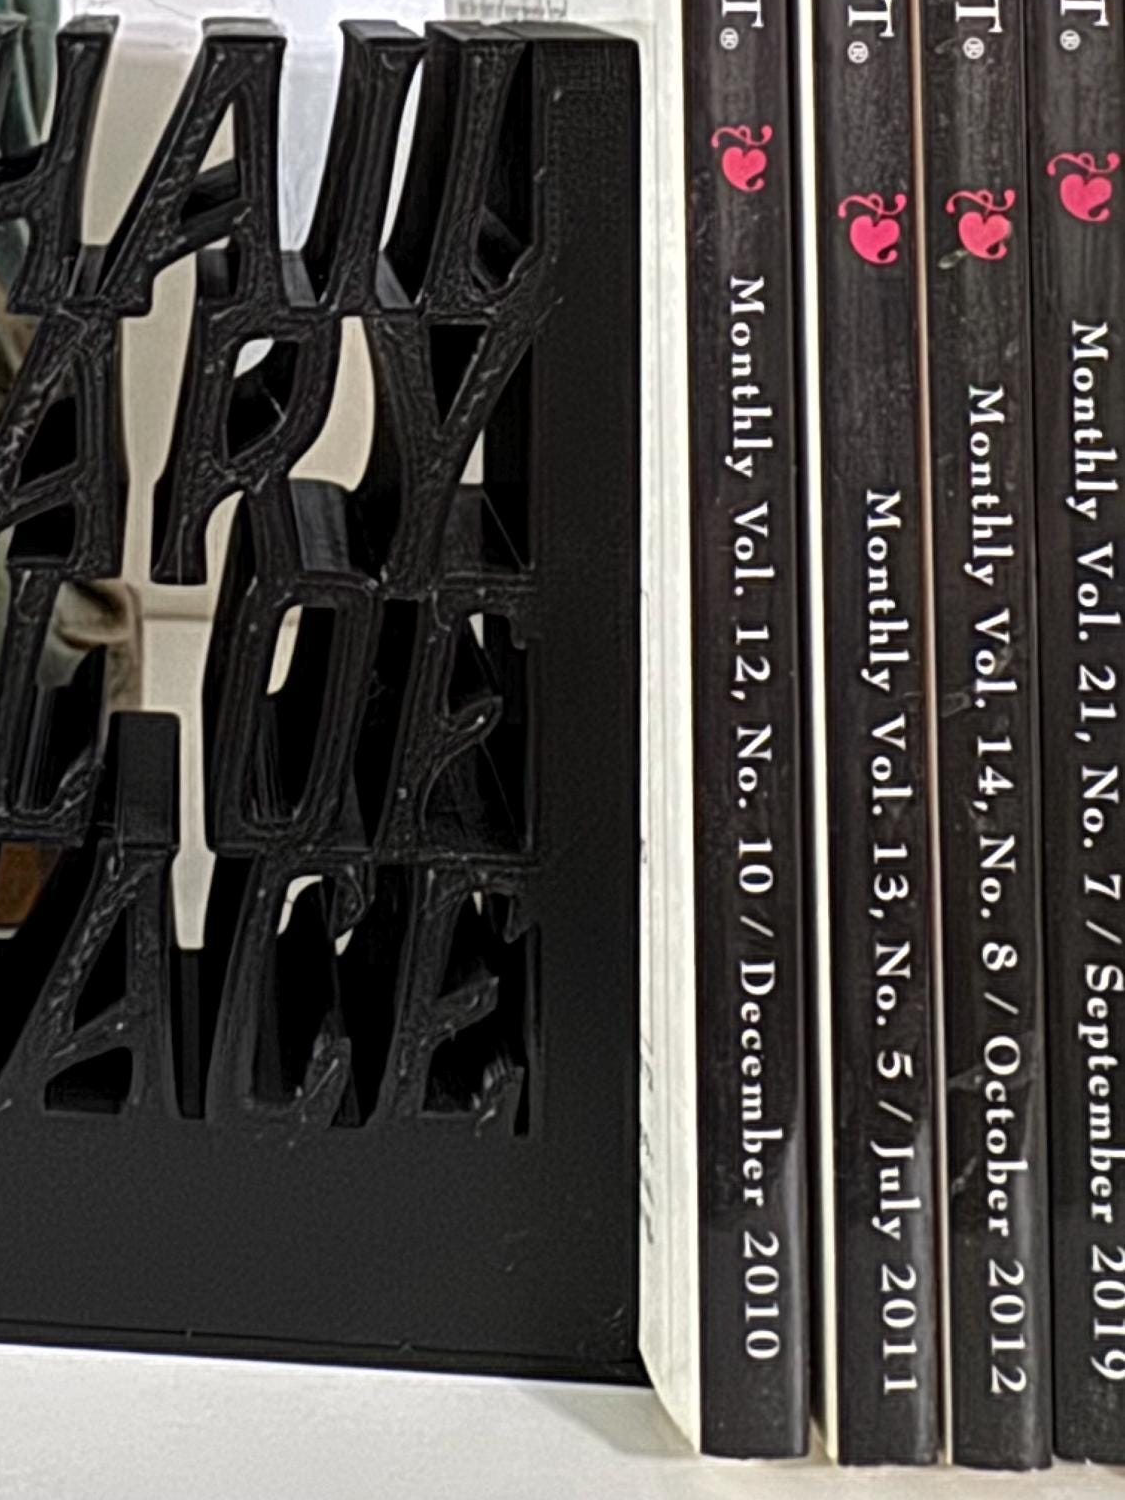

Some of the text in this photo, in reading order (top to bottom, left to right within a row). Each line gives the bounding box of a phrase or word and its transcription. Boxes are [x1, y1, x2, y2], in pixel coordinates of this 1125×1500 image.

[724, 276, 773, 478] Monthly
[1066, 320, 1119, 521] Monthly
[964, 386, 1014, 586] Monthly
[734, 502, 775, 596] Vol.
[861, 489, 910, 692] Monthly
[1077, 542, 1122, 641] Vol.
[732, 626, 771, 700] 12,
[975, 609, 1018, 708] Vol.
[1075, 665, 1117, 743] 21,
[737, 725, 772, 808] No.
[871, 714, 913, 815] Vol.
[973, 738, 1014, 812] 14,
[1082, 766, 1119, 848] No.
[738, 839, 773, 893] 10
[869, 844, 909, 919] 13,
[979, 835, 1016, 918] No.
[1084, 874, 1122, 900] 7
[875, 942, 912, 1026] No.
[982, 942, 1018, 971] 8
[740, 961, 783, 1207] December
[877, 1051, 914, 1079] 5
[1078, 963, 1125, 1224] September
[984, 1036, 1029, 1238] October
[871, 1141, 922, 1241] July
[744, 1231, 780, 1359] 2010
[881, 1264, 918, 1394] 2011
[989, 1259, 1028, 1394] 2012
[1091, 1245, 1125, 1381] 2019
